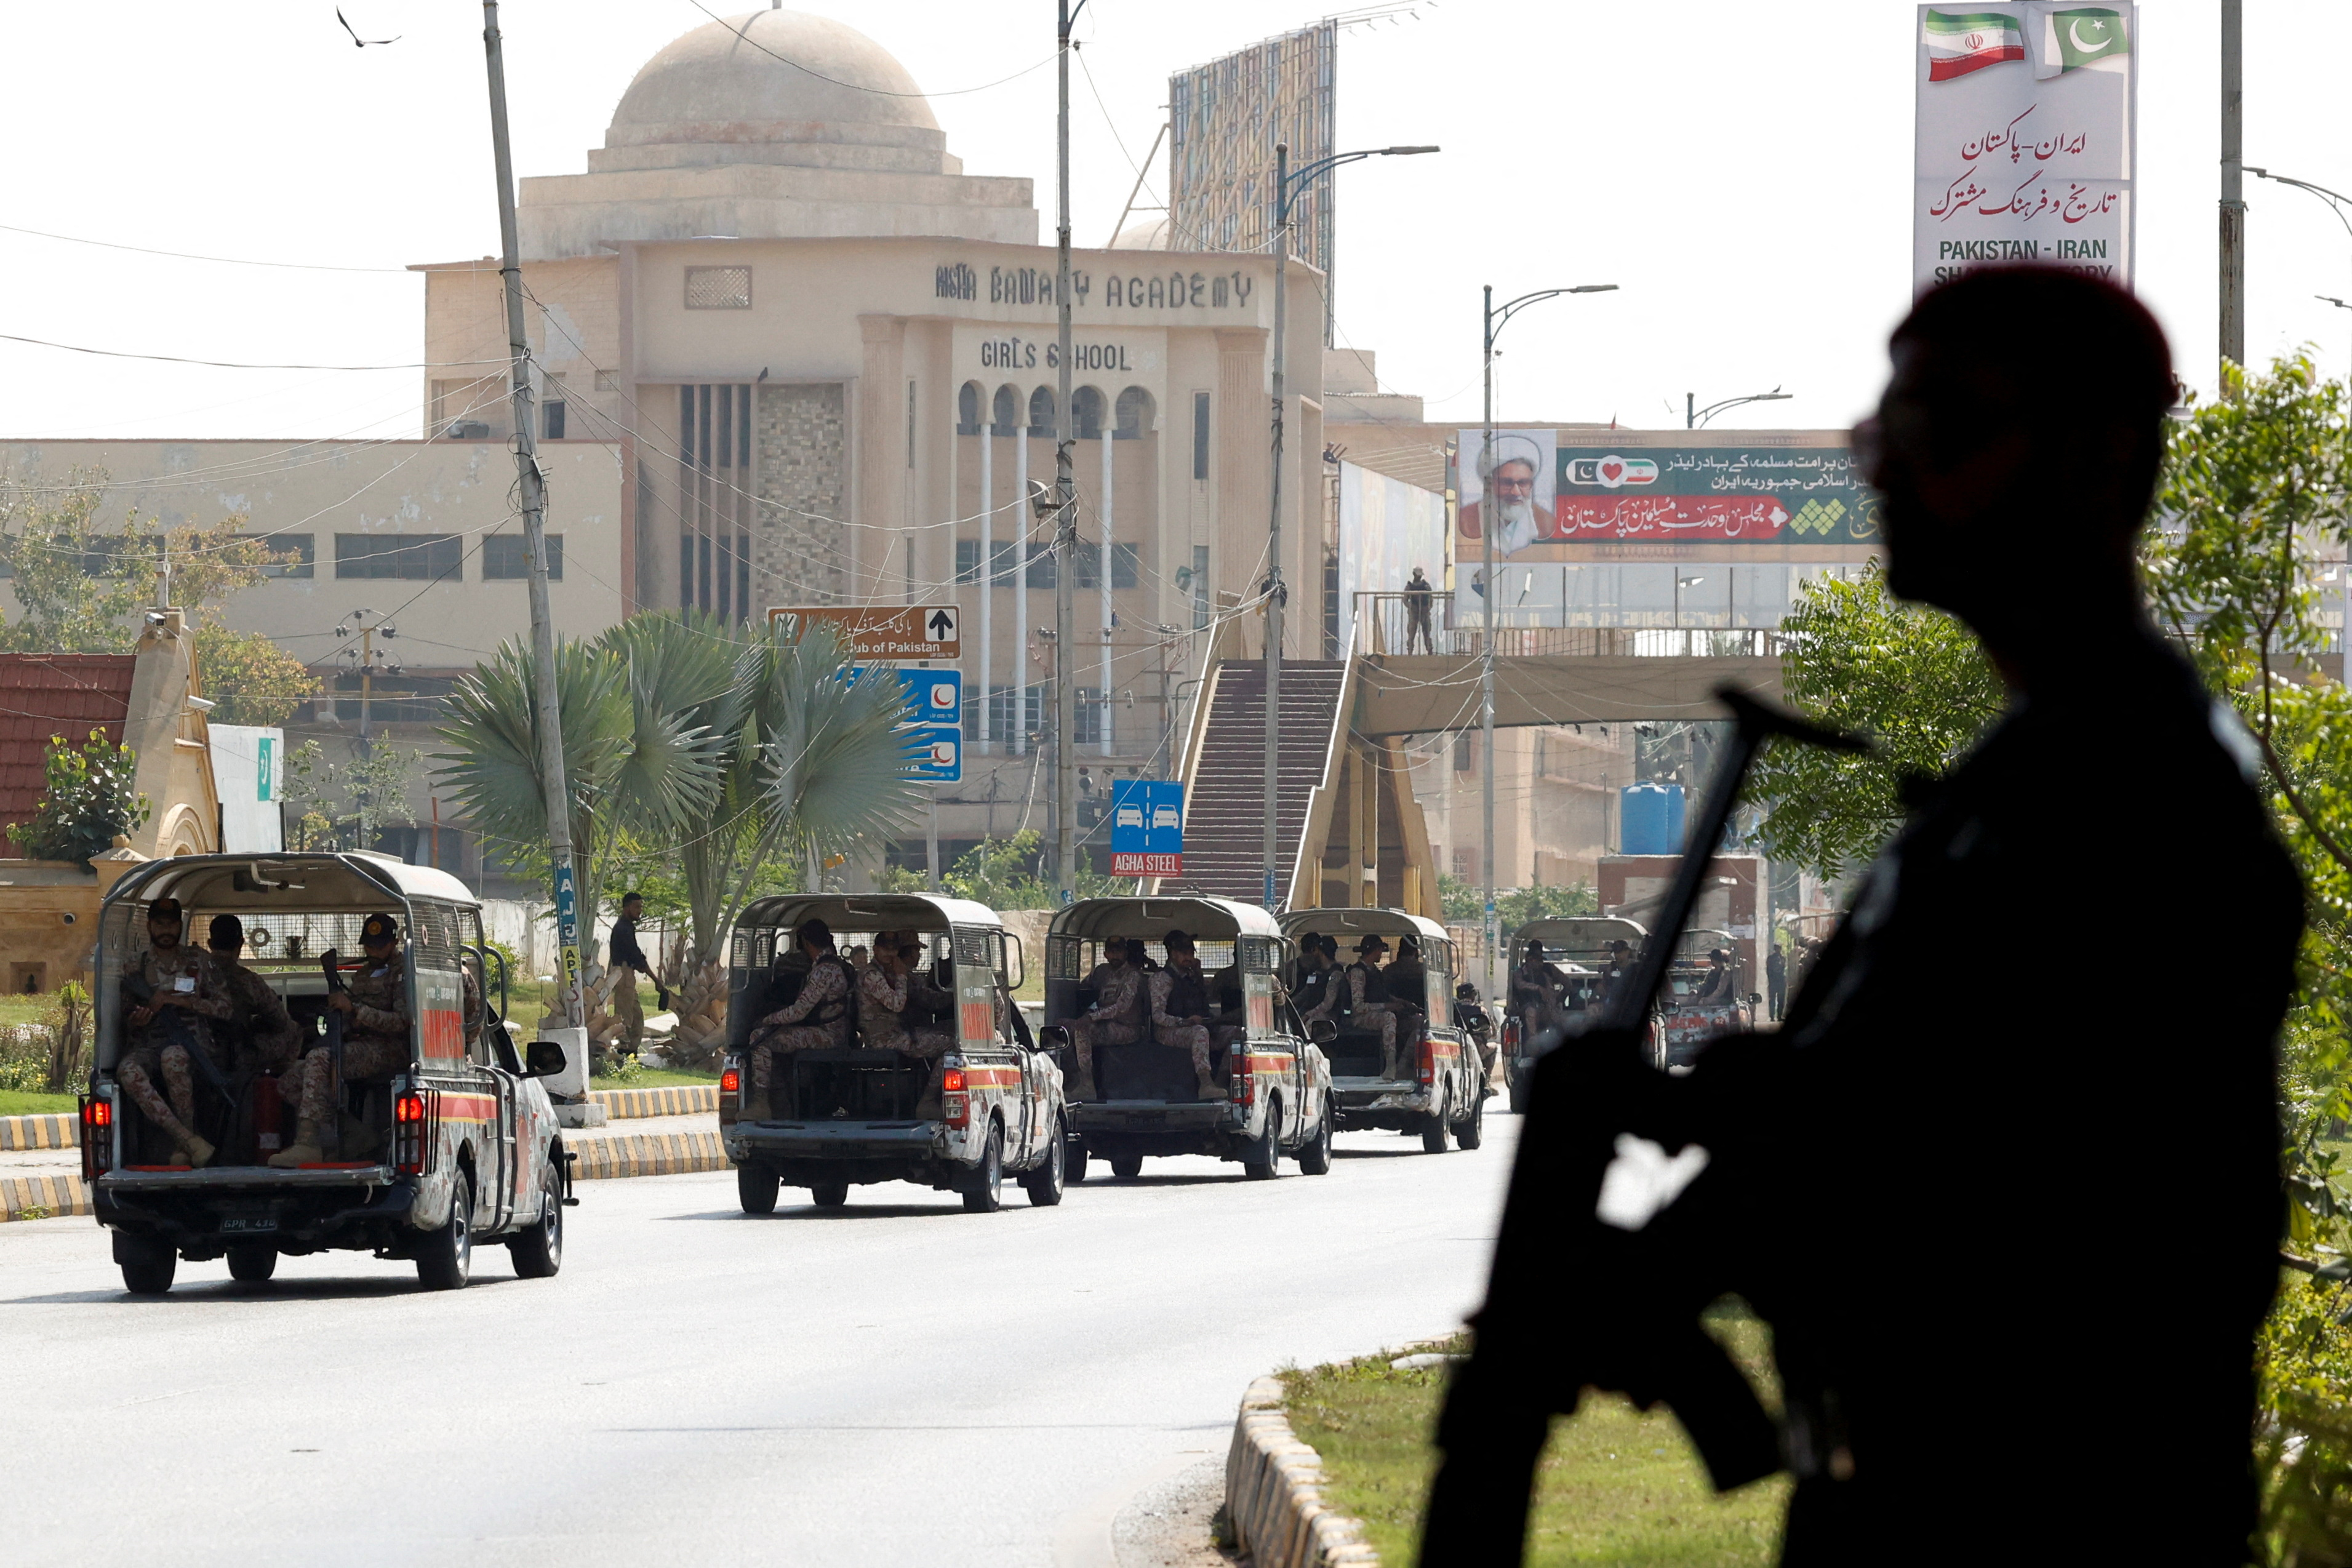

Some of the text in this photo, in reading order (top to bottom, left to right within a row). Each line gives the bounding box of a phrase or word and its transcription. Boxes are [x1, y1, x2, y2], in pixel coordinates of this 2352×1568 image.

[2049, 199, 2060, 214] و
[2063, 183, 2116, 223] تاریخ
[1940, 240, 2038, 260] PAKISTAN
[2057, 239, 2106, 259] IRAN
[990, 265, 1090, 306] BAWAY
[982, 337, 1132, 371] GIRLS SHOOL
[1711, 474, 1740, 490] ایران
[873, 641, 886, 653] of
[888, 642, 940, 653] Pakistan
[1114, 854, 1178, 872] AGHA STEEL
